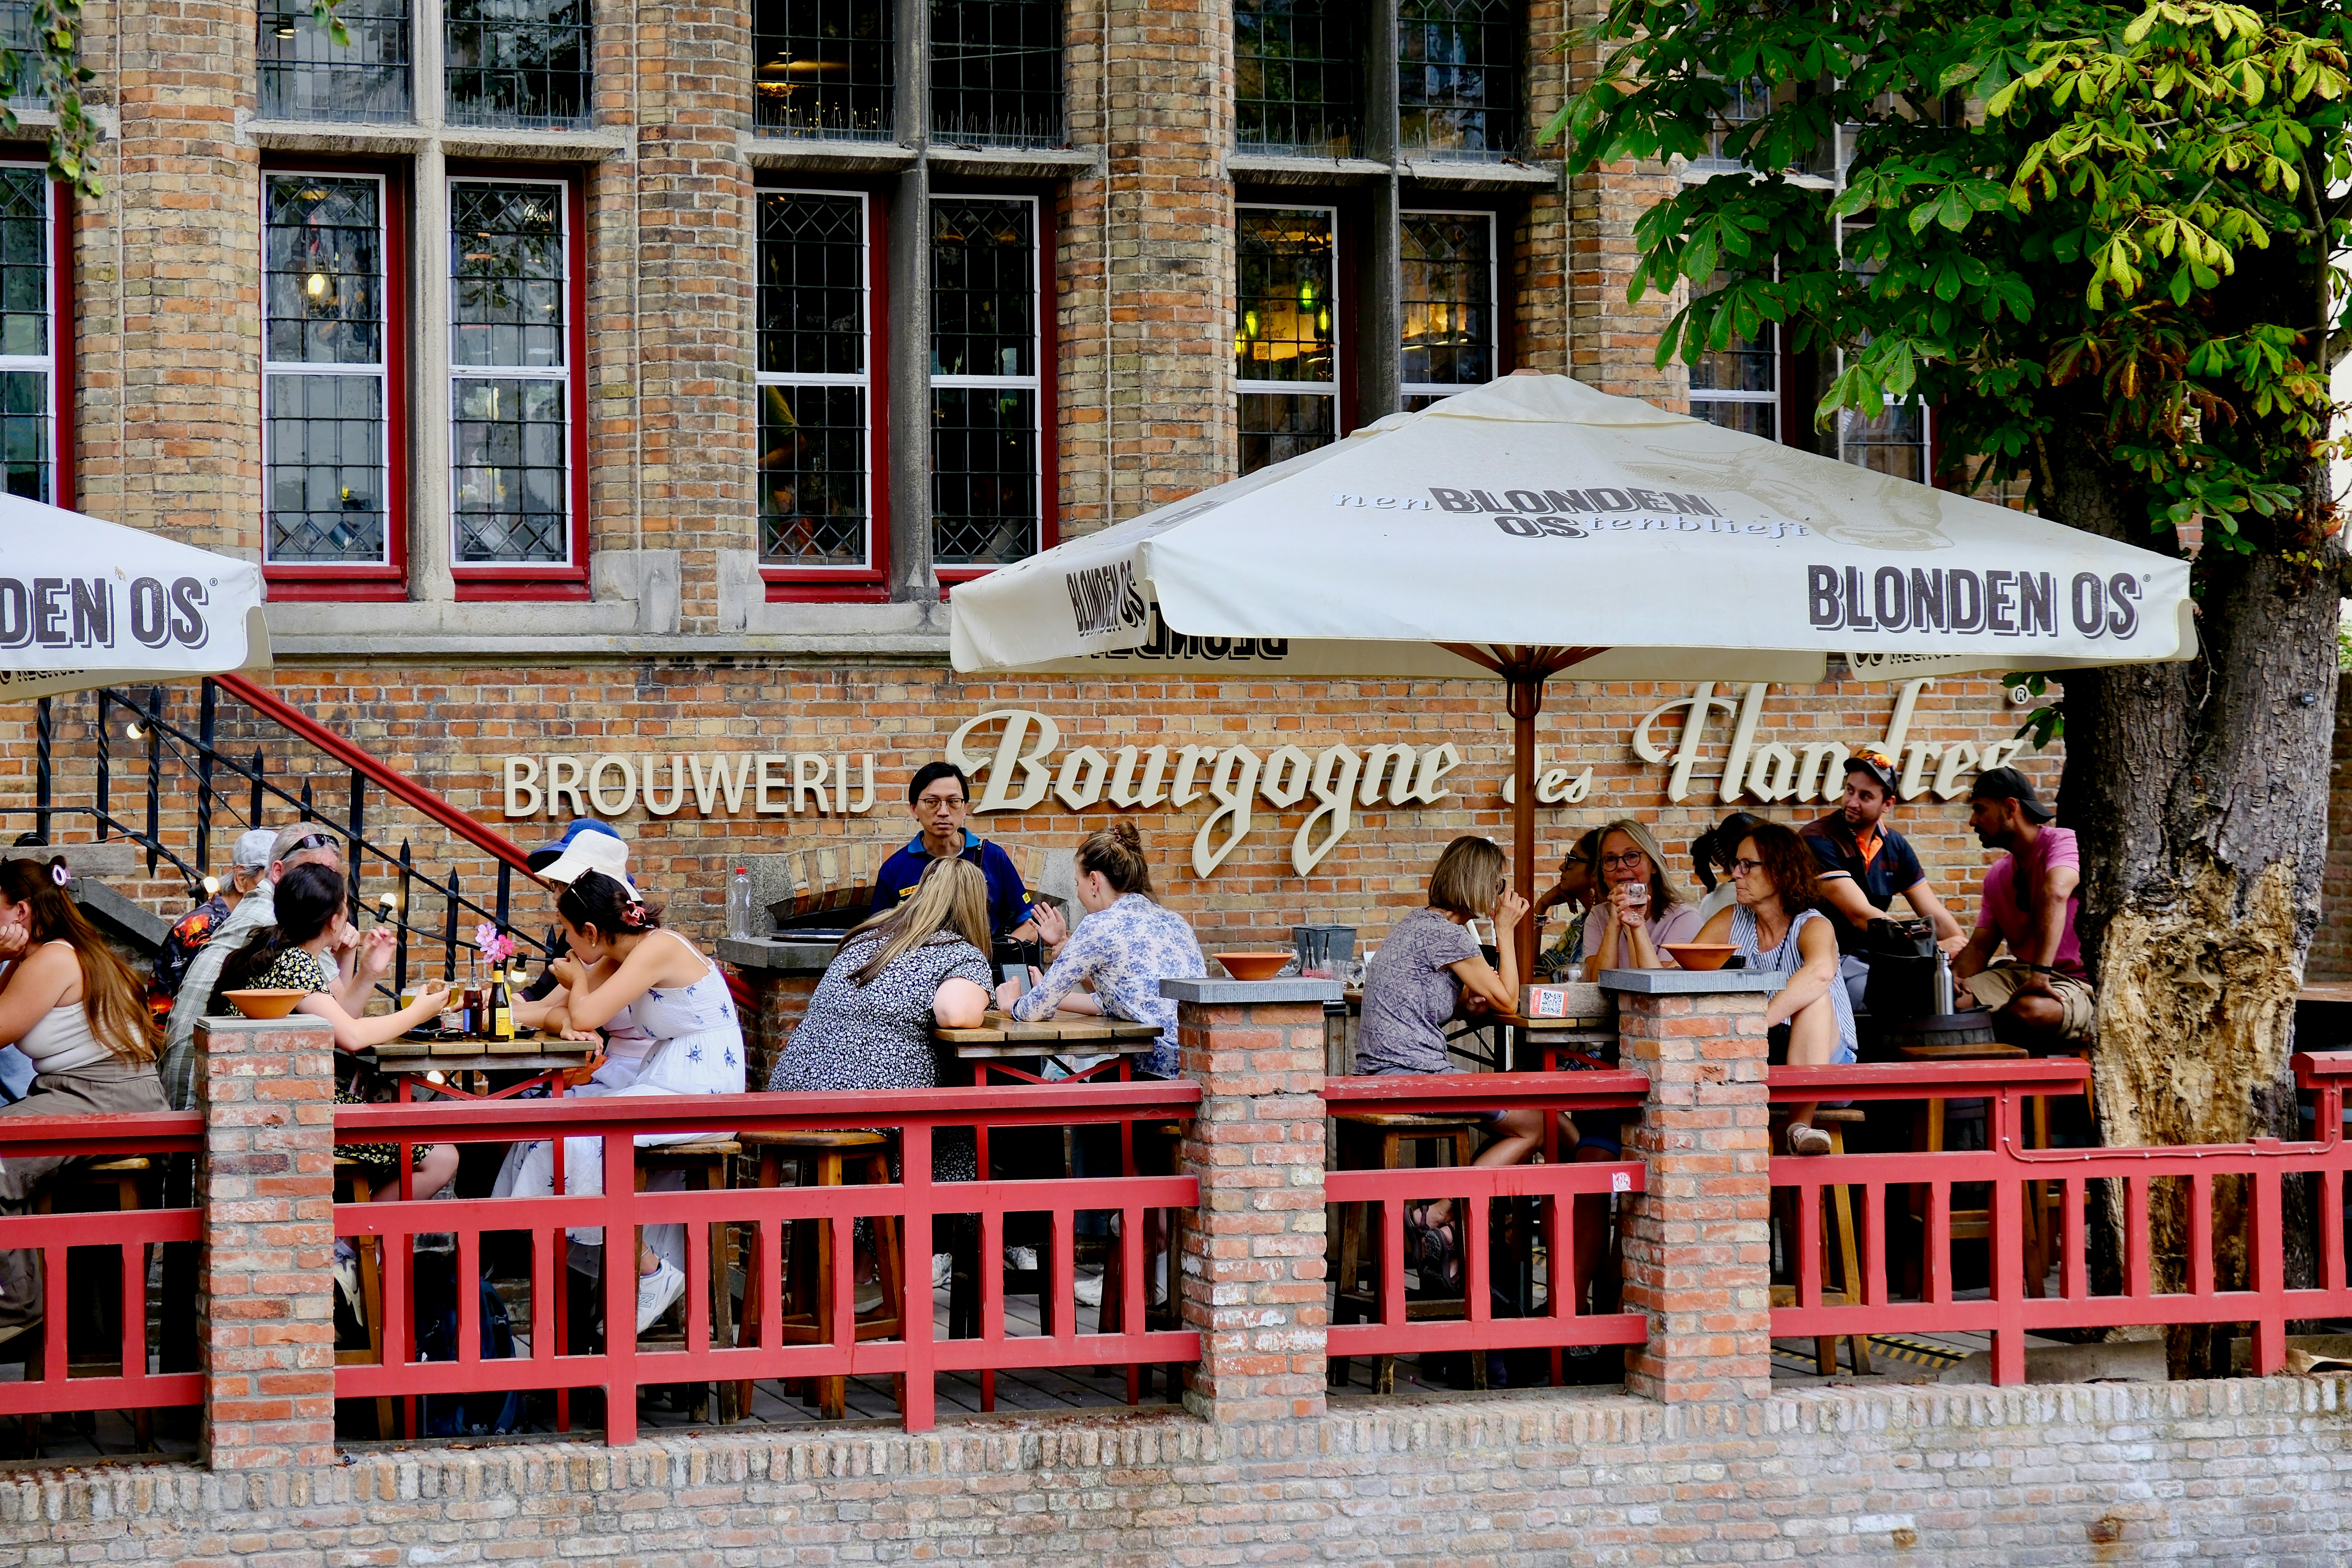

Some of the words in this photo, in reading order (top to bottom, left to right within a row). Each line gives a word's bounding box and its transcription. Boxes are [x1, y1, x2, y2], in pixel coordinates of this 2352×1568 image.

[1428, 487, 1723, 518] BLONDEN
[1066, 564, 1121, 637] BLONDEN
[1808, 564, 2058, 637] BLONDEN
[504, 753, 874, 817] BROUWERIJ
[945, 709, 1462, 879] Bourgogne
